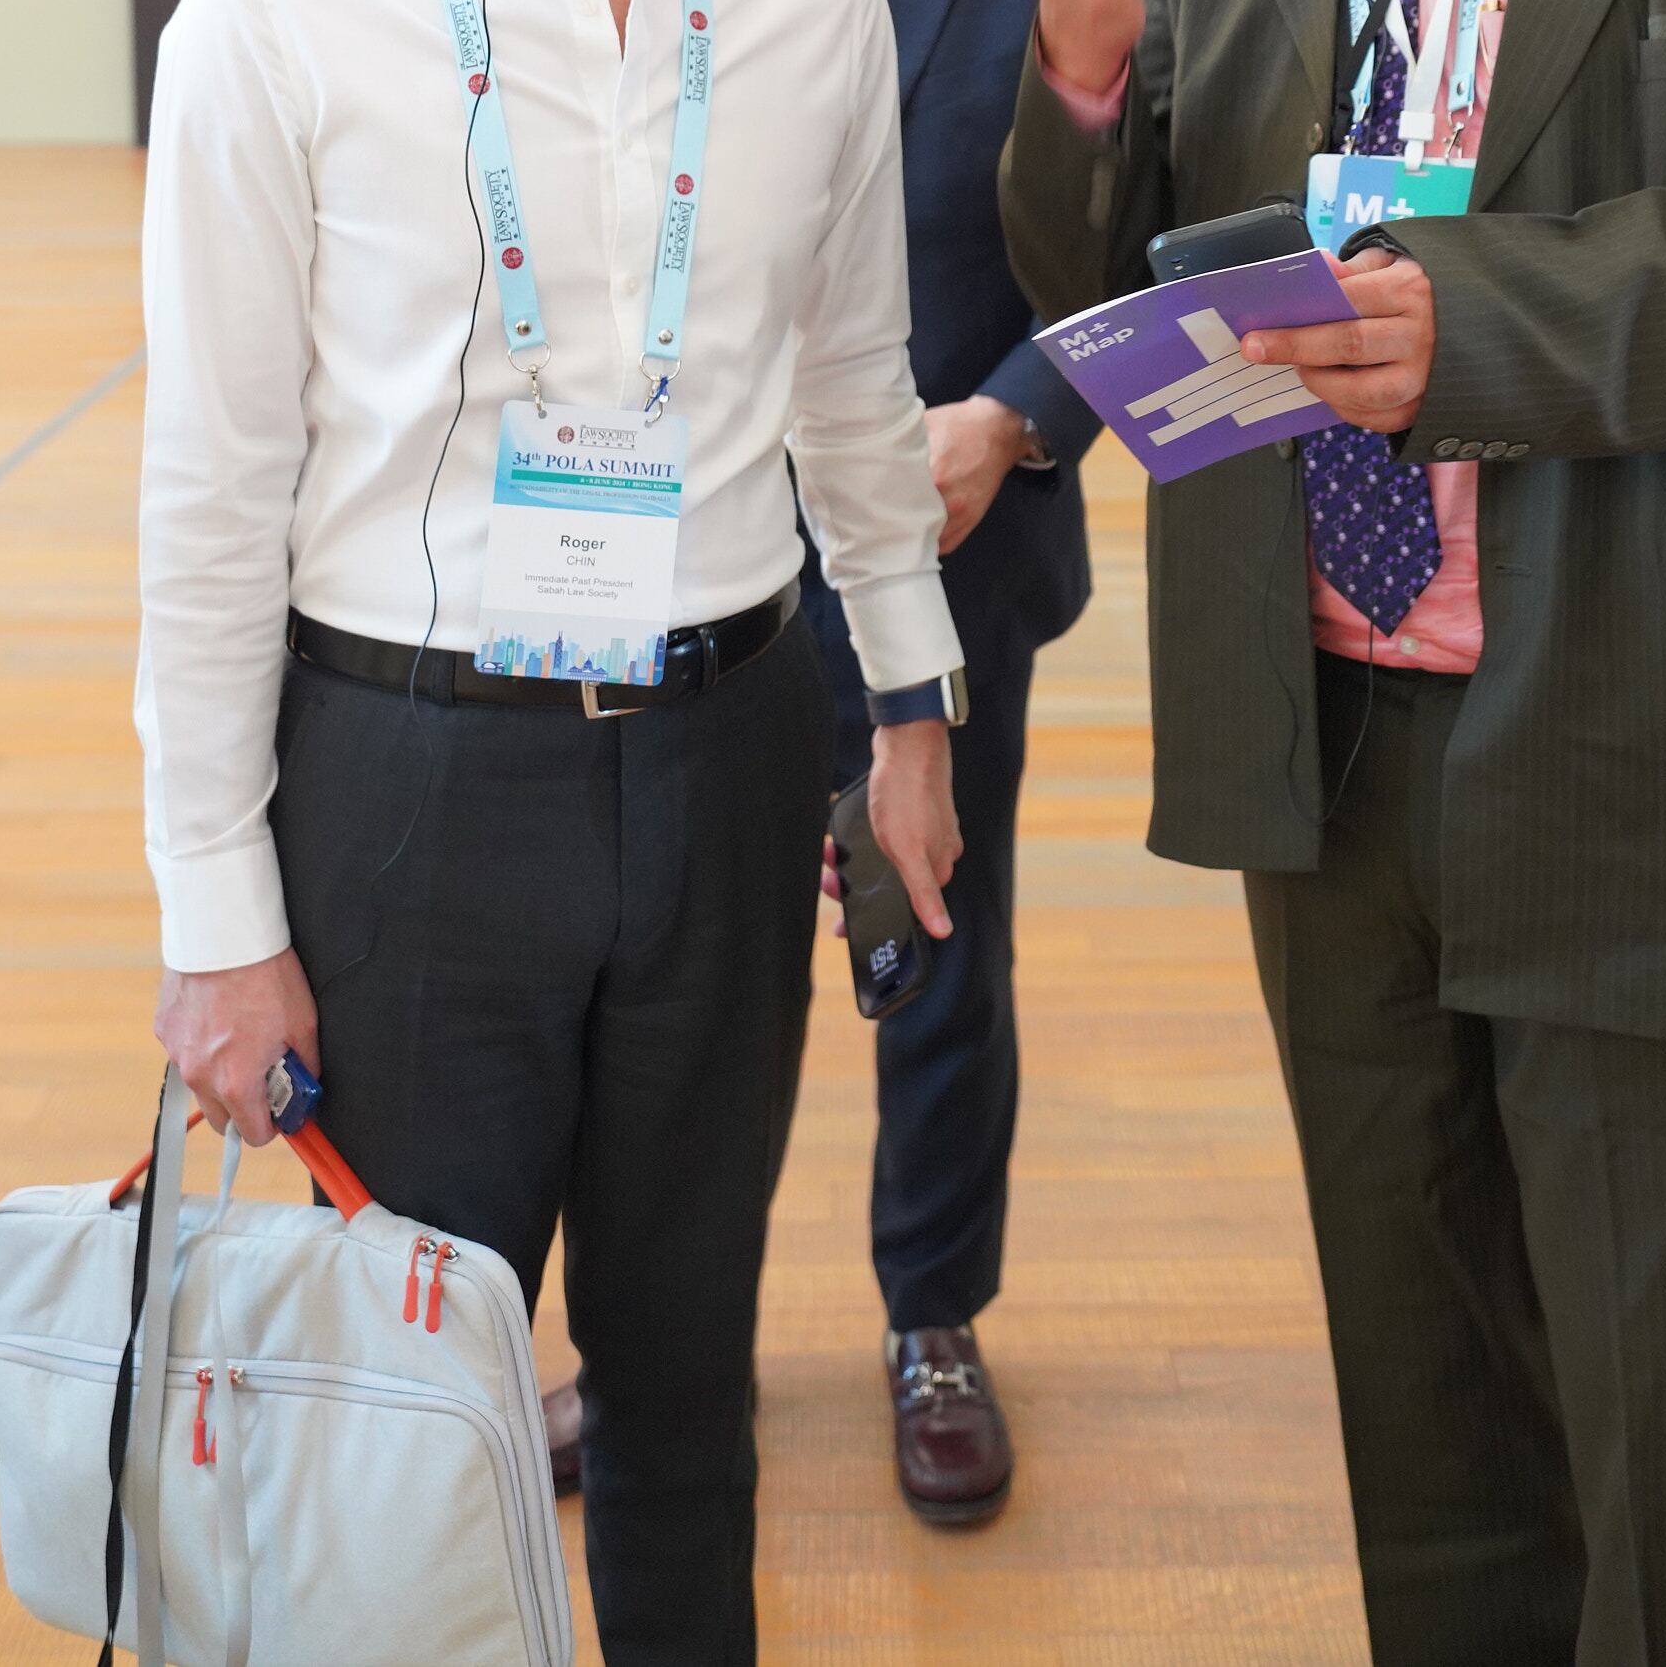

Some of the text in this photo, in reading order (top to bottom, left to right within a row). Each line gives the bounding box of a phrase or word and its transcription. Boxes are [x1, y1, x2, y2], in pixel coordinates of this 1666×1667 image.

[1344, 192, 1415, 225] M+
[1058, 322, 1110, 350] M+
[1067, 327, 1134, 362] Map
[512, 451, 675, 477] 34th POLA SUMMIT
[560, 535, 606, 552] Roger
[566, 555, 596, 567] CHIN
[525, 573, 634, 589] Immediate Past President
[537, 585, 619, 601] Sabah Law Society
